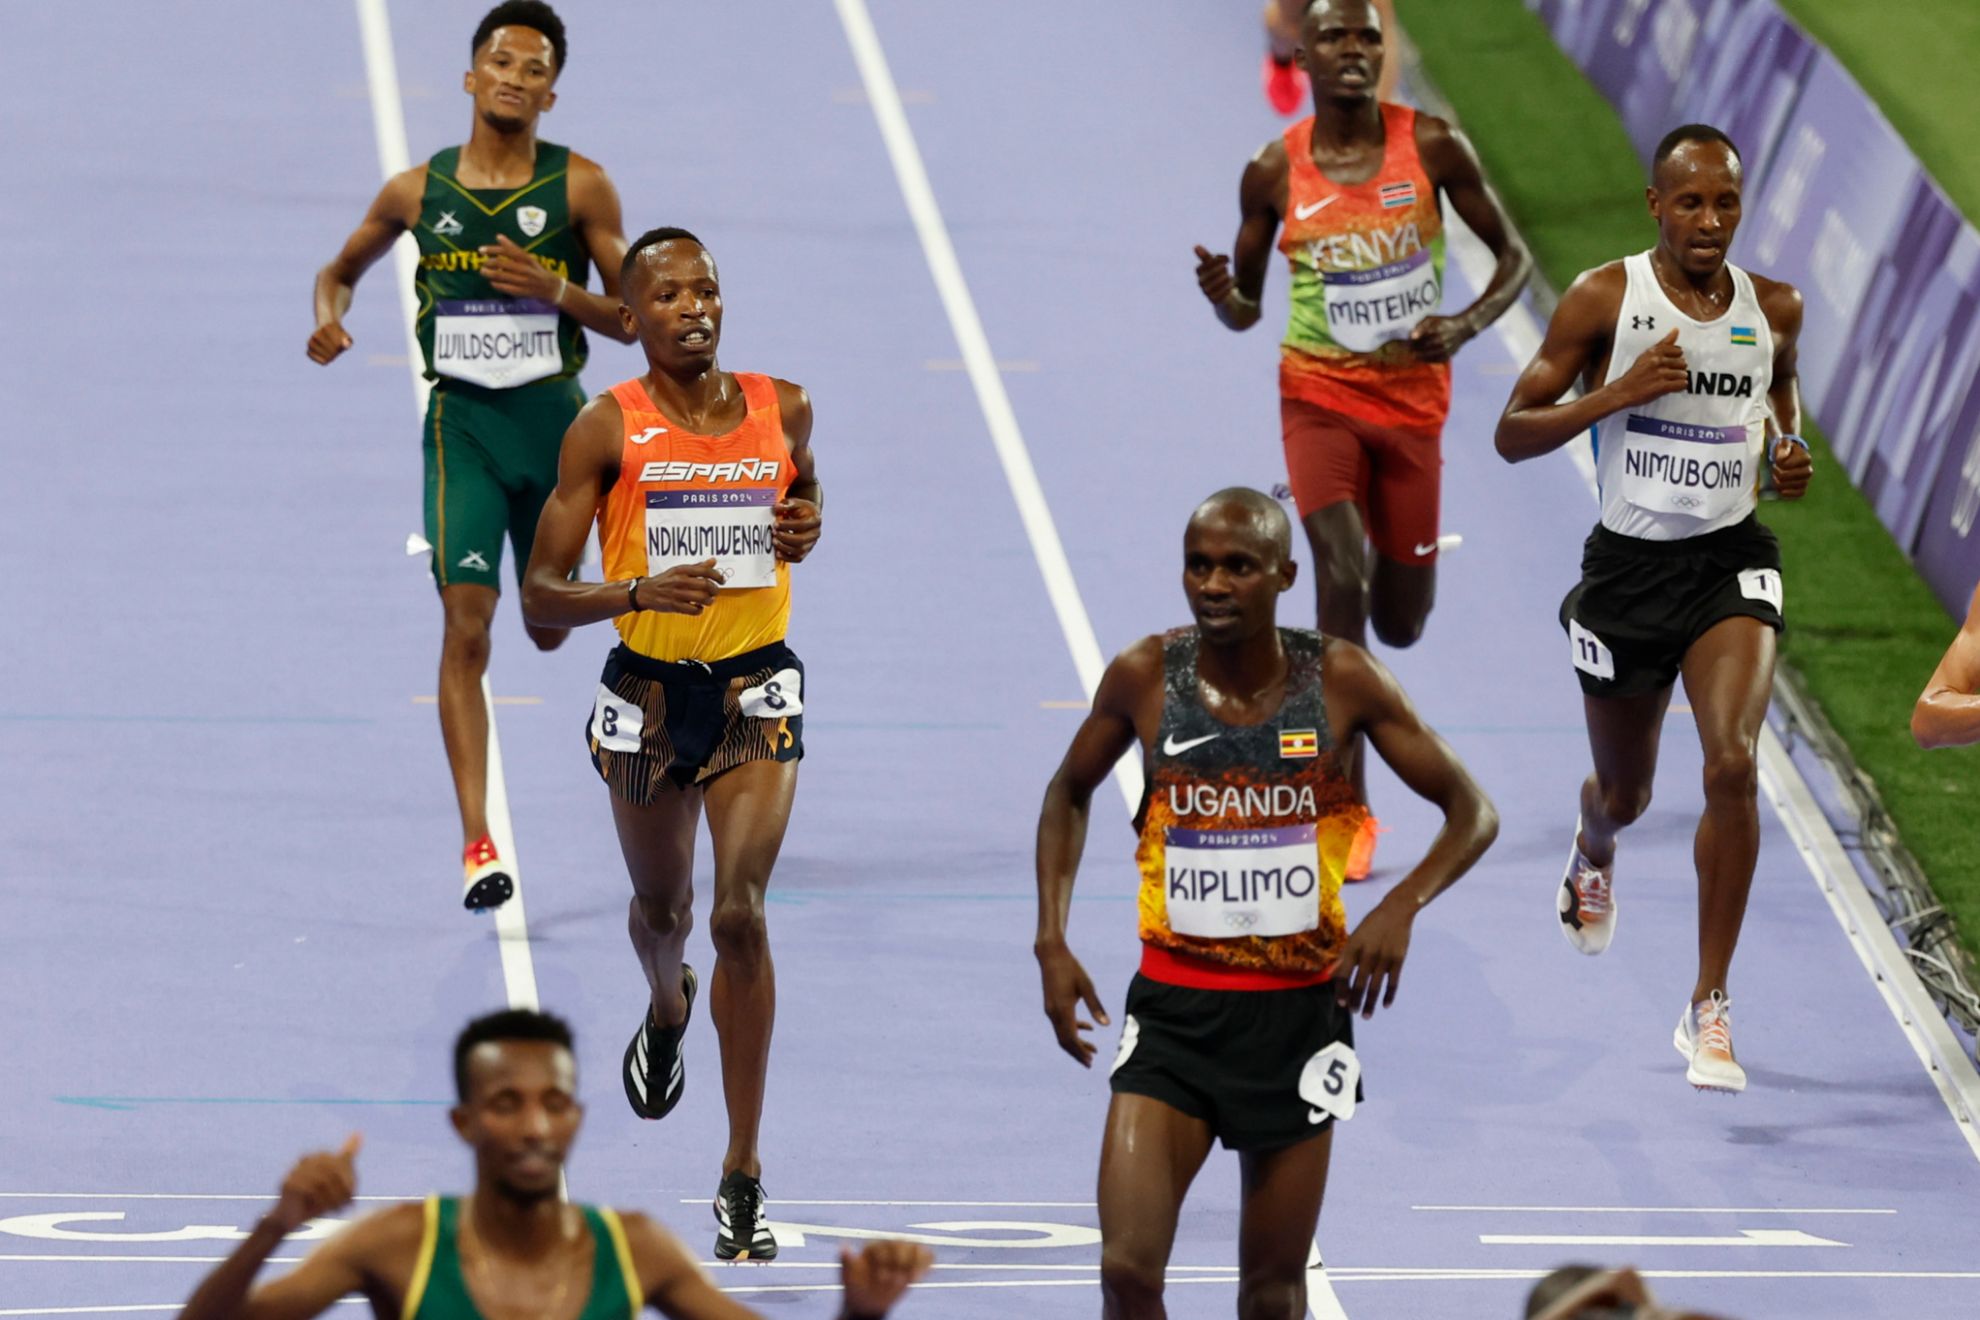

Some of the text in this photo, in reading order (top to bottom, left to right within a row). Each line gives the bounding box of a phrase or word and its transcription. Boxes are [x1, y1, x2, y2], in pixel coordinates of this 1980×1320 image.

[1308, 223, 1422, 269] KENYA
[1328, 280, 1440, 326] MATEIKO
[438, 330, 554, 360] WILDSCHUTT
[1661, 424, 1694, 437] PARIS
[638, 458, 779, 482] ESPAÑA
[1625, 448, 1742, 490] NIMUBONA
[683, 493, 752, 503] PARIS 2024
[1578, 637, 1599, 665] 11
[764, 681, 787, 710] 8
[602, 705, 619, 737] 8
[1170, 785, 1317, 817] UGANDA
[1200, 833, 1277, 845] PARIS 2024
[1170, 865, 1315, 902] KIPLIMO
[1323, 1059, 1348, 1096] 5
